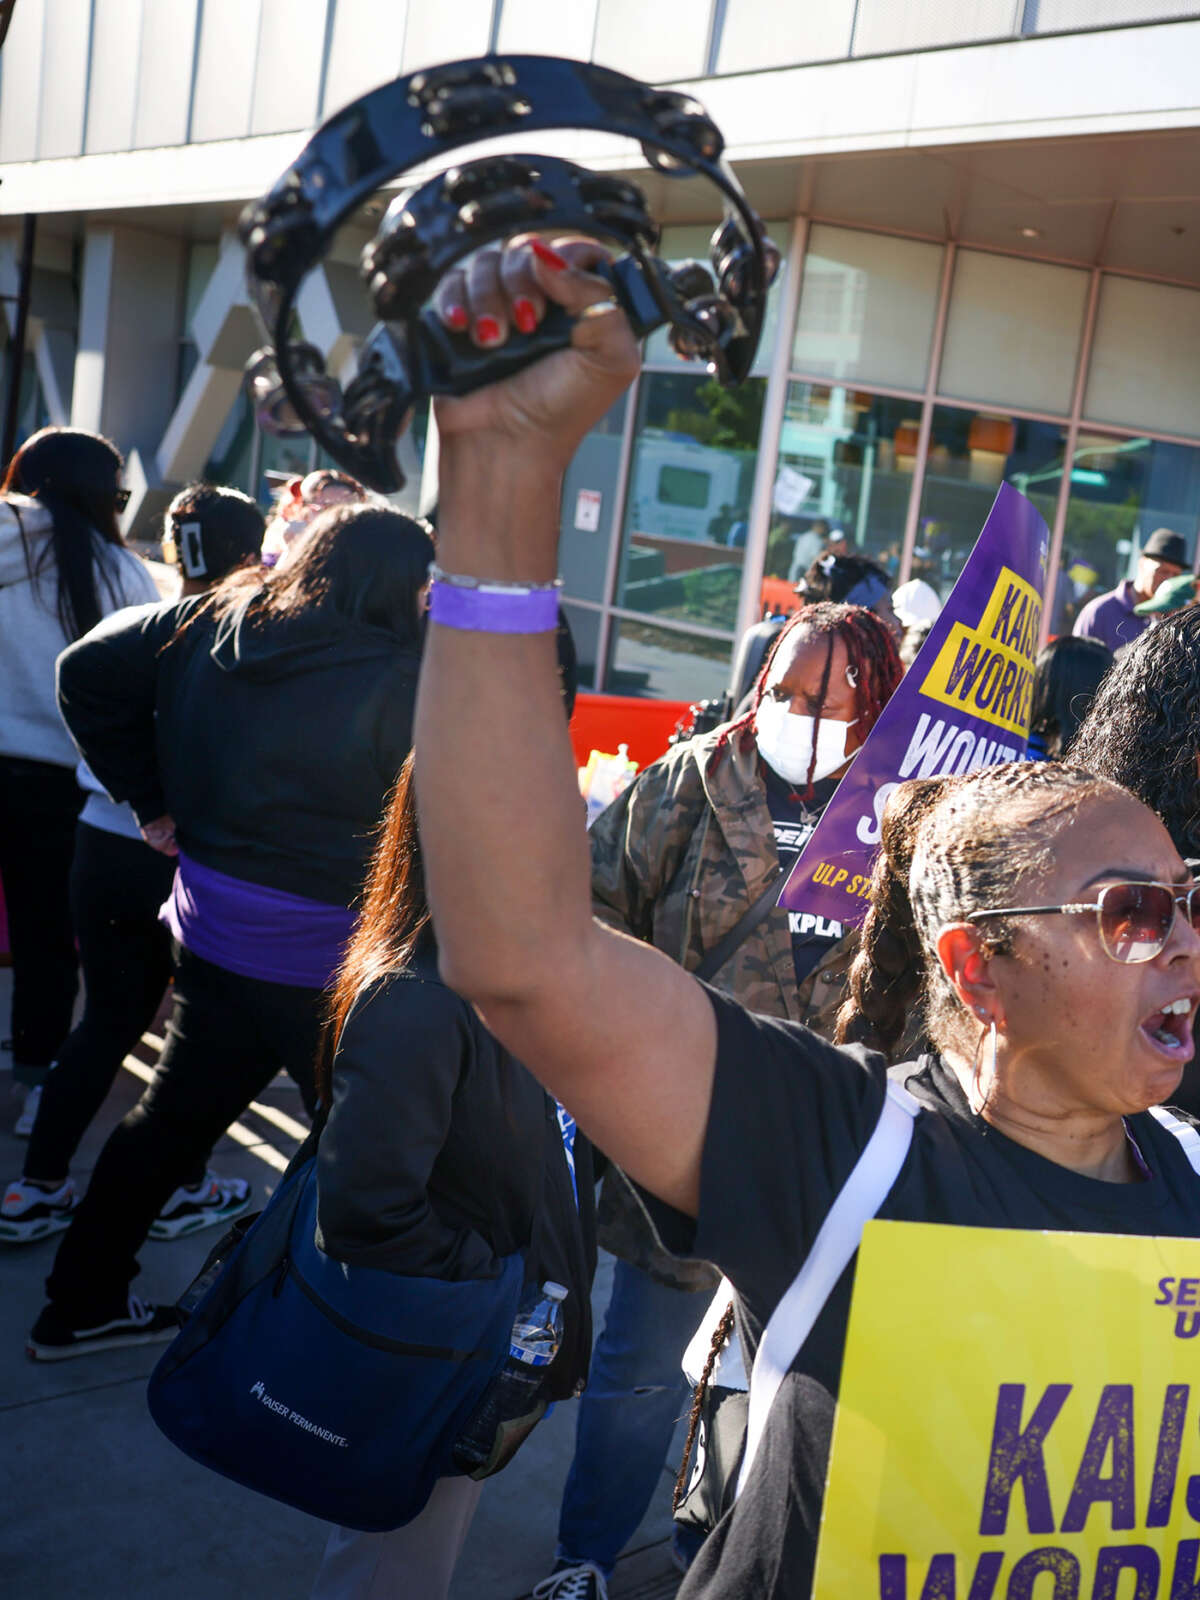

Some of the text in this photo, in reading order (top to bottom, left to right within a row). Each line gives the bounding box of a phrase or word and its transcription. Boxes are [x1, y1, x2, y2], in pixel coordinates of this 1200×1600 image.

[812, 862, 849, 887] ULP
[262, 1394, 347, 1447] KAISER PERMANENTE
